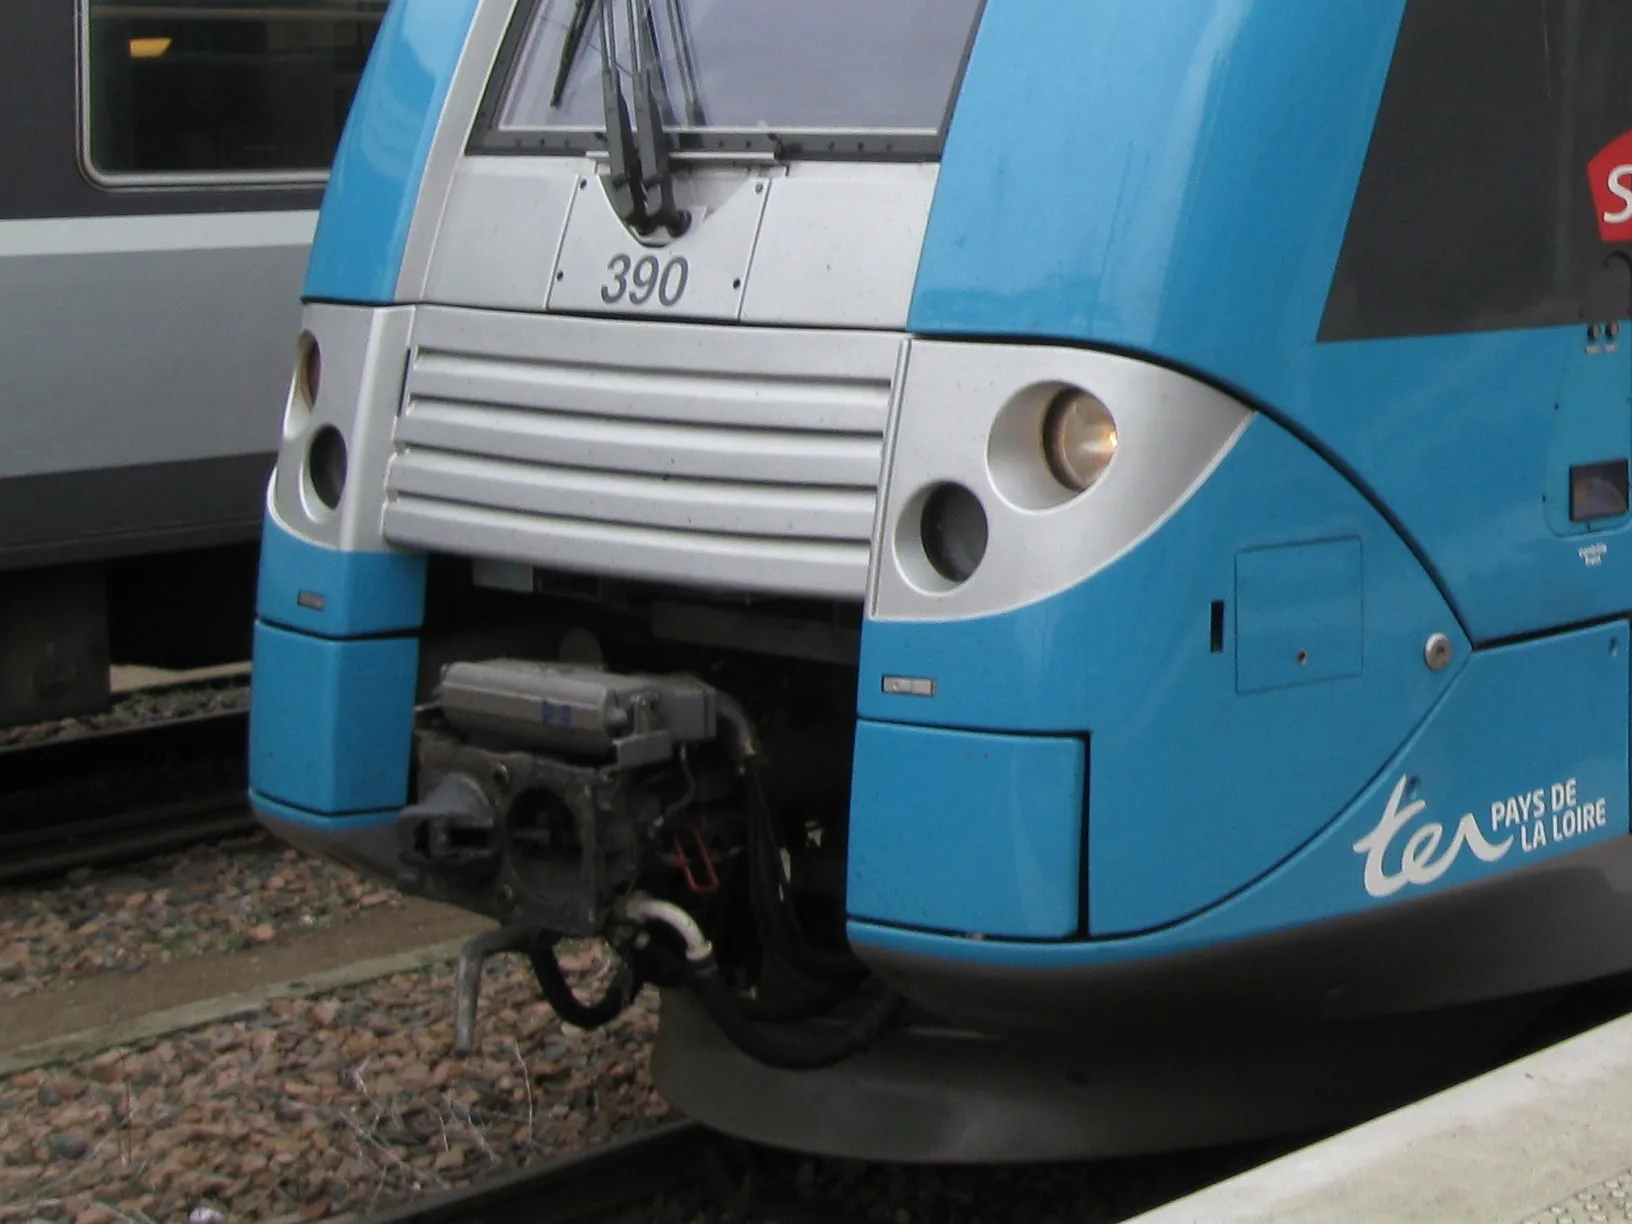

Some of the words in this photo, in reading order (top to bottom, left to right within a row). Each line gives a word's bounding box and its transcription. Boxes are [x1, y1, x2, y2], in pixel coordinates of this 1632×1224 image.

[600, 252, 690, 307] 390
[1491, 787, 1546, 833] PAYS
[1551, 777, 1578, 814] DE
[1520, 819, 1547, 854] LA
[1552, 797, 1607, 843] LOIRE
